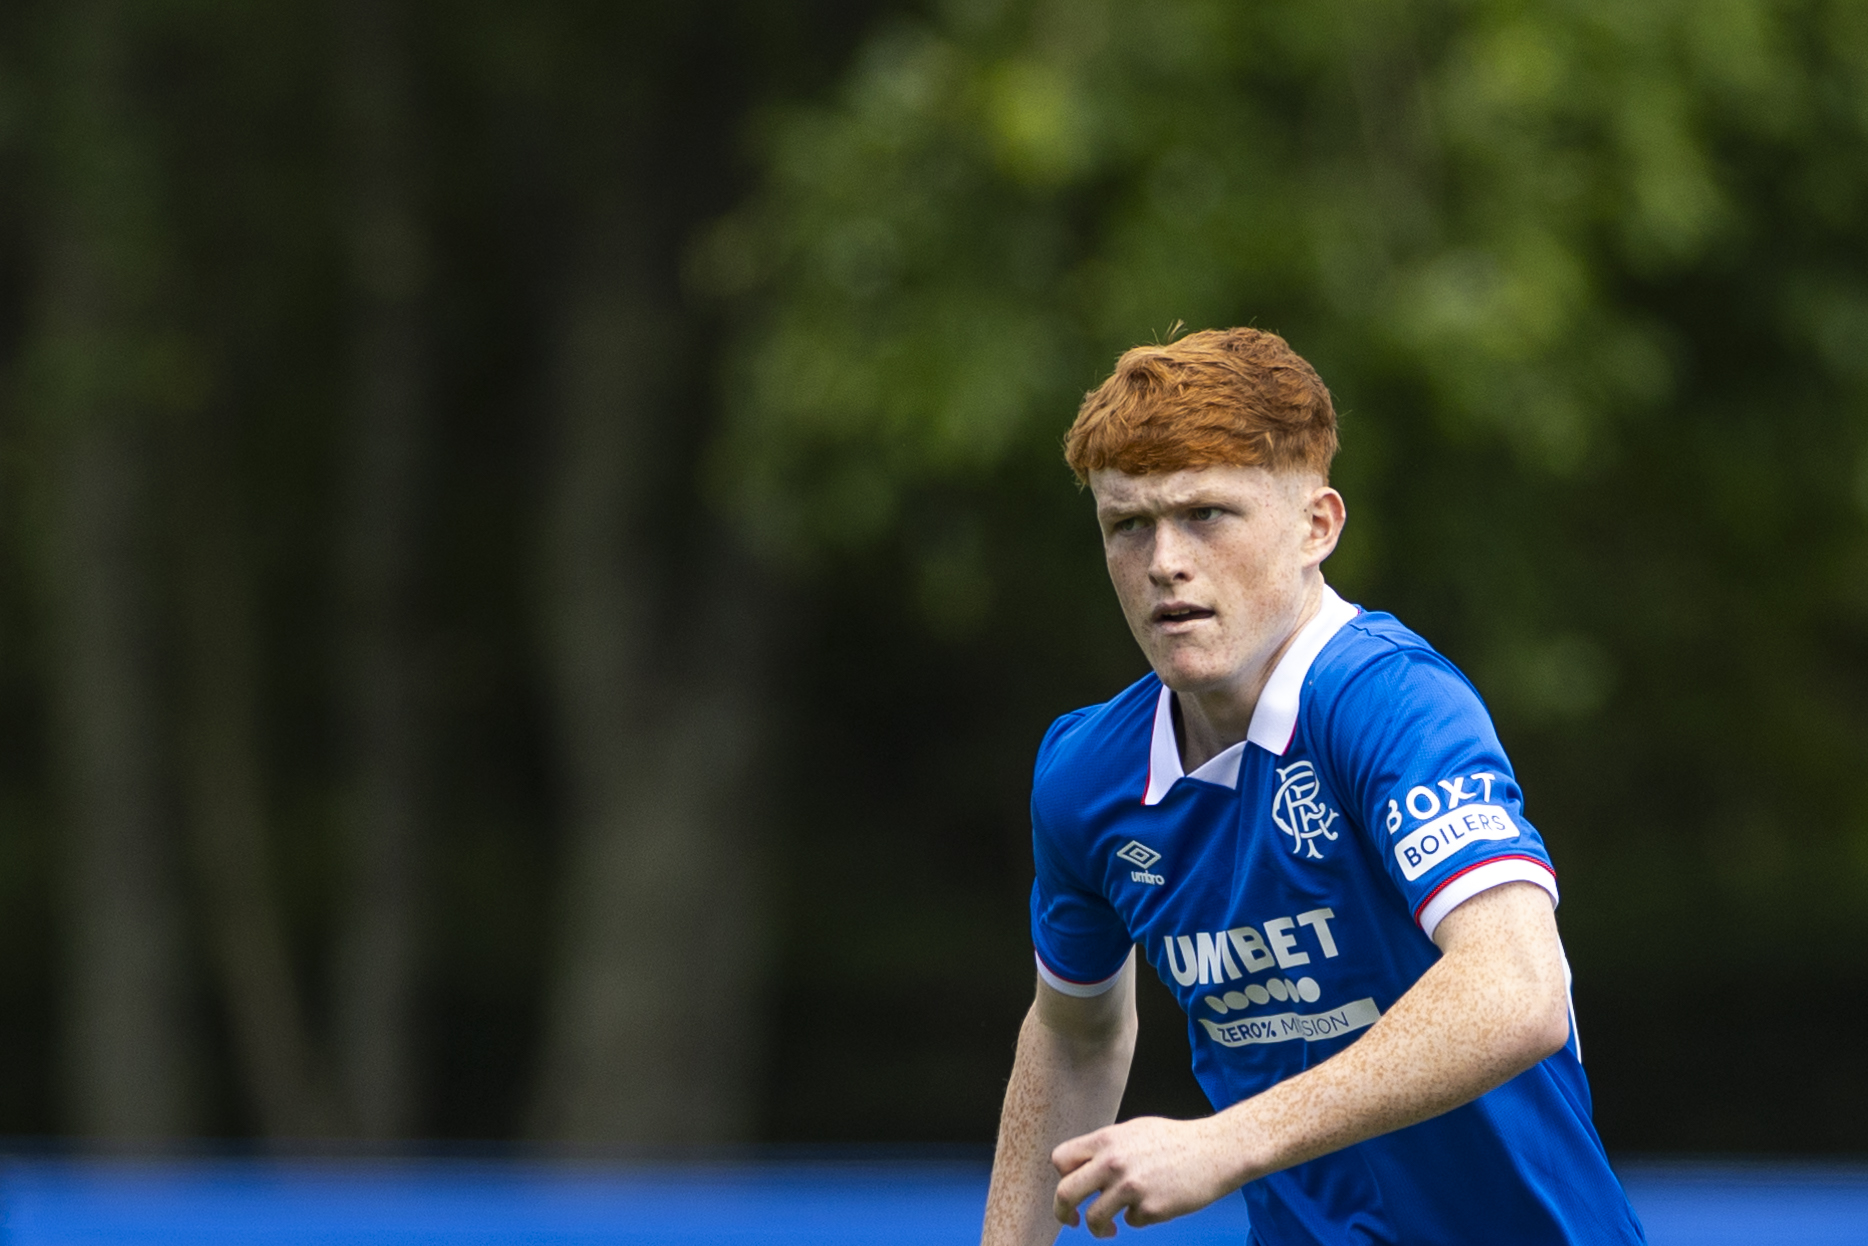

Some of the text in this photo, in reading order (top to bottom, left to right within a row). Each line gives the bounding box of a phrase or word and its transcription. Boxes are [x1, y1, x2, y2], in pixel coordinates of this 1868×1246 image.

[1386, 772, 1496, 836] BOXT
[1403, 813, 1507, 869] BOILERS
[1130, 869, 1166, 886] umbro
[1280, 1011, 1350, 1037] MSION
